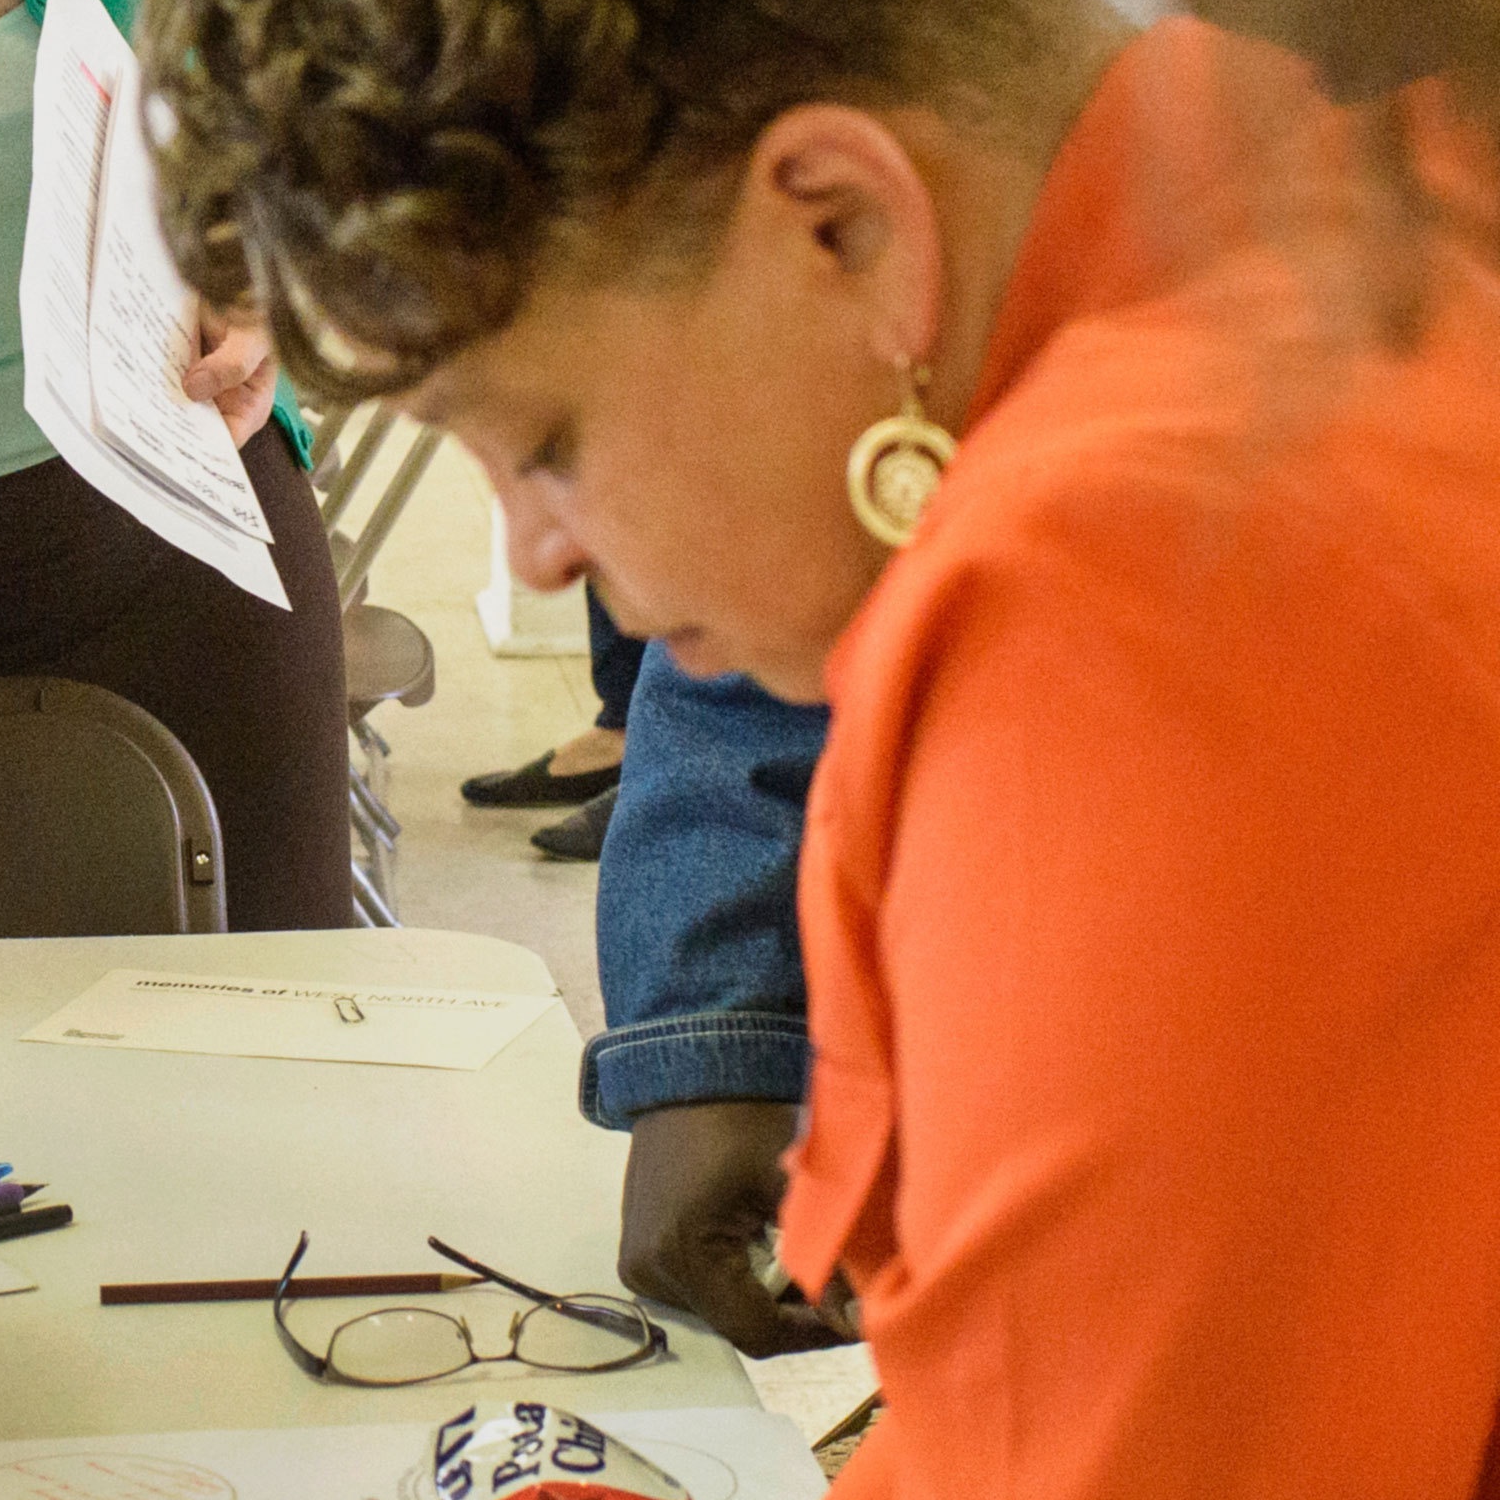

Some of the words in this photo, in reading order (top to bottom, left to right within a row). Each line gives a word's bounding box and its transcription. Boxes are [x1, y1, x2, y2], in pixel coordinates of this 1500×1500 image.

[135, 979, 255, 994] memories
[261, 988, 288, 996] of
[367, 993, 457, 1005] NORTH
